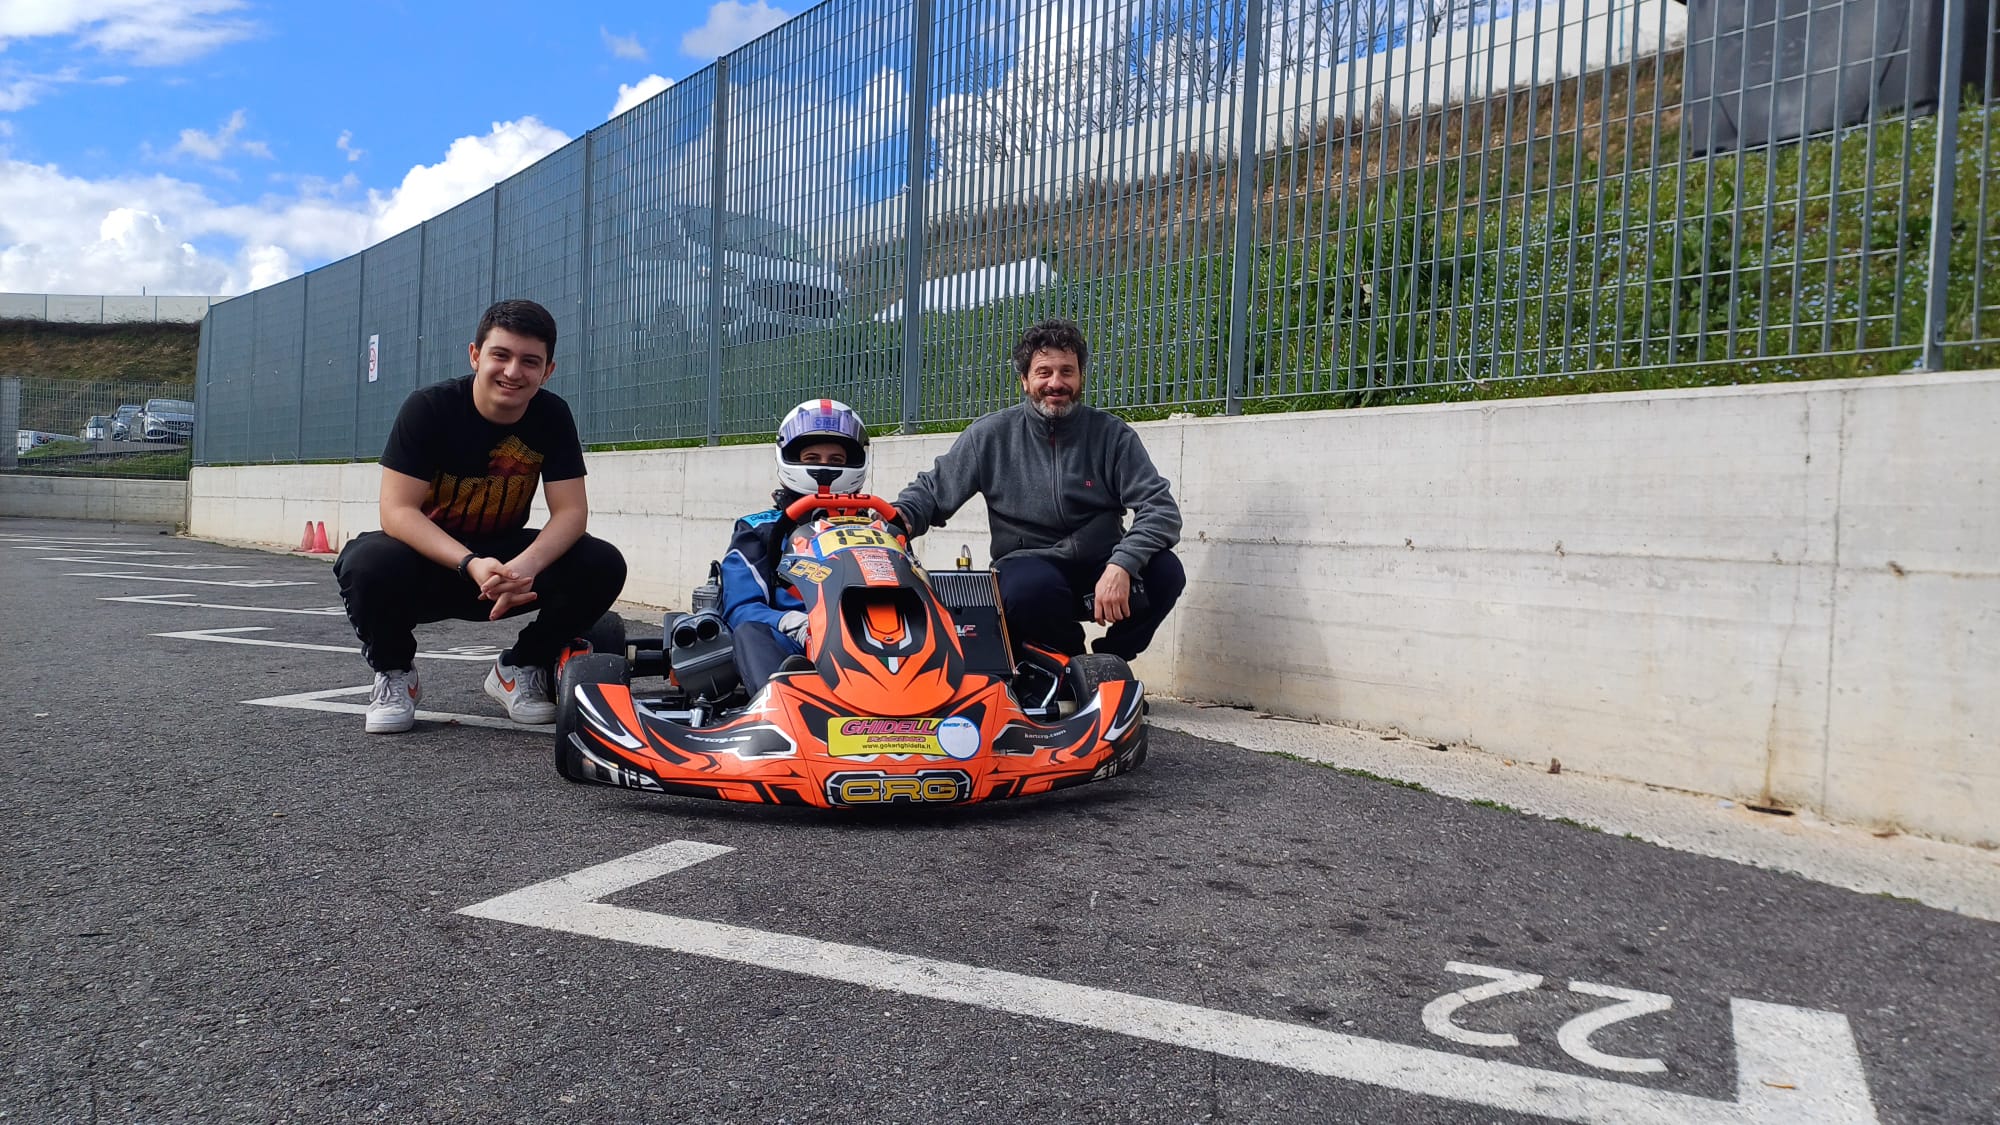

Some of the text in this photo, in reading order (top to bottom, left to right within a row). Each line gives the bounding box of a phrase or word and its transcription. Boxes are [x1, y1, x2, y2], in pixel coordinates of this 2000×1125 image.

[835, 529, 885, 545] 151
[789, 559, 833, 584] CRG
[841, 778, 957, 803] CRG
[1420, 960, 1673, 1074] 22
